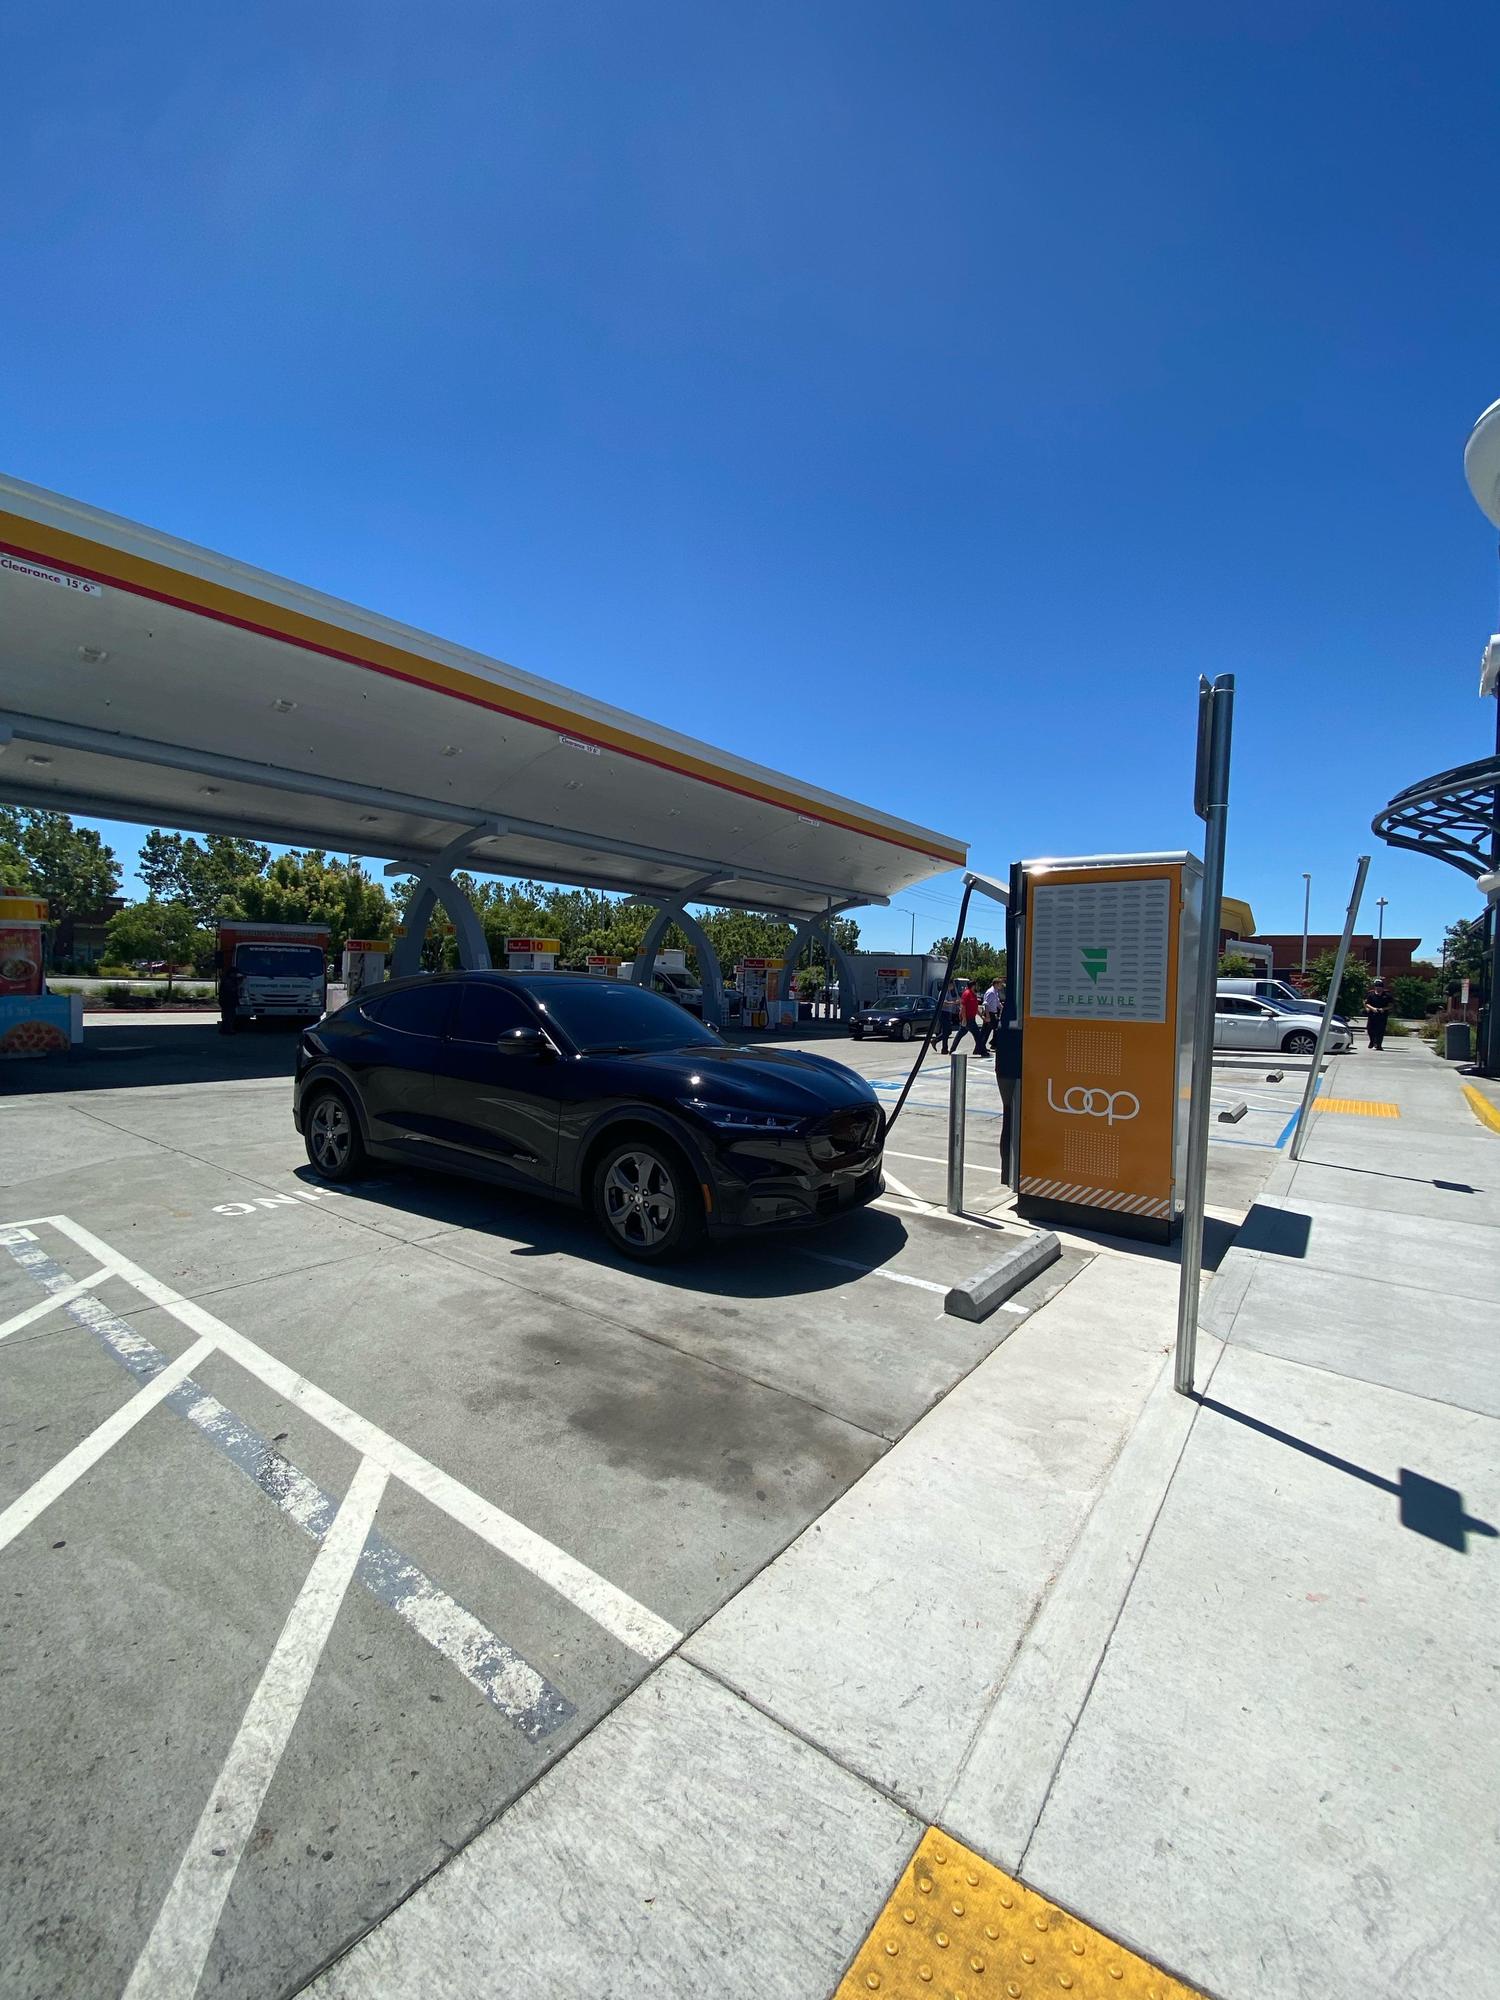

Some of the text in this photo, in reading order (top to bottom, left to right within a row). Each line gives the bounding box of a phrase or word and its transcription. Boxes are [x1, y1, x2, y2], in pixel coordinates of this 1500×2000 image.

[1, 559, 60, 583] Clearance
[531, 942, 543, 951] 10
[1058, 994, 1136, 1006] FREEWIRE
